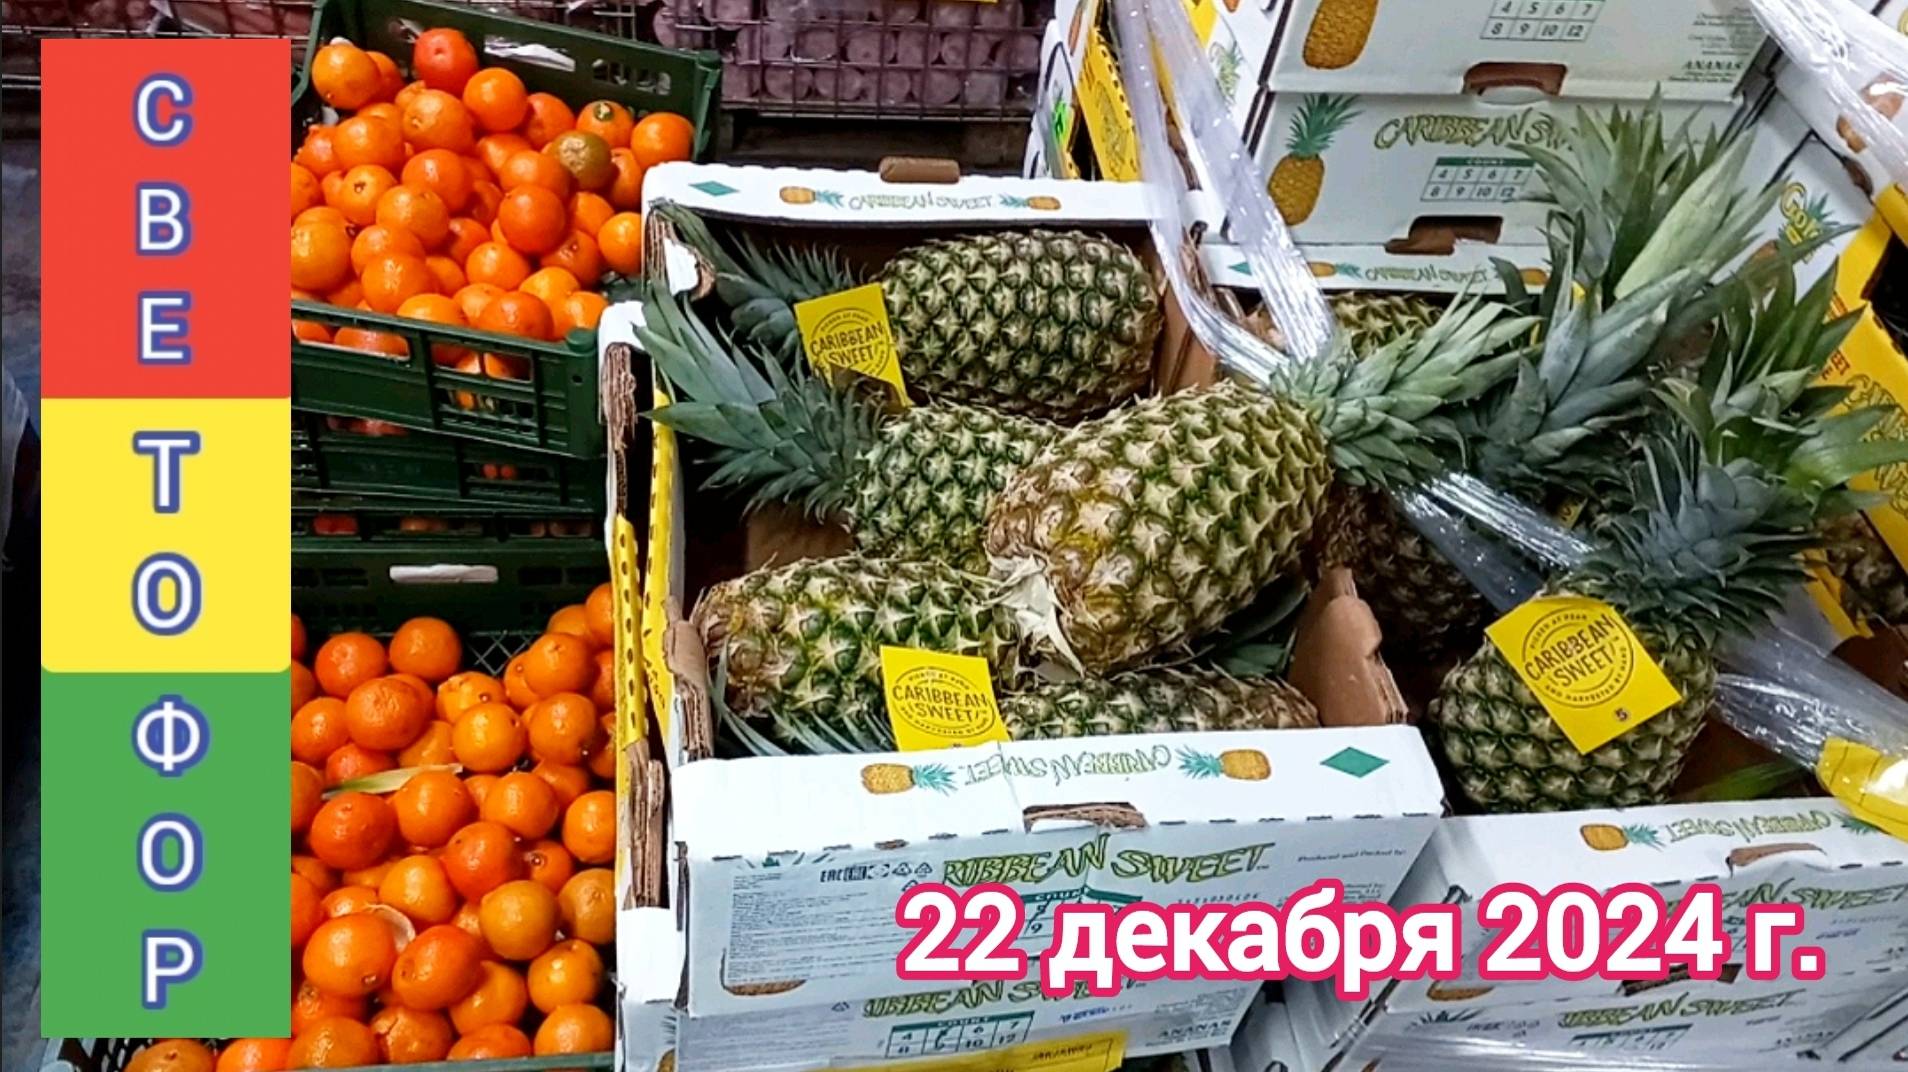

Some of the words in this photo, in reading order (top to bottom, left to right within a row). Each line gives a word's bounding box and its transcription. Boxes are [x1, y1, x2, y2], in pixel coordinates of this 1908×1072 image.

[1541, 24, 1559, 37] 10
[1373, 106, 1534, 150] CARIBBEAN
[1463, 168, 1473, 179] 5
[1487, 168, 1497, 179] 6
[1456, 186, 1466, 198] 9
[1476, 186, 1492, 198] 10
[1500, 187, 1516, 198] 12
[810, 321, 884, 357] CARIBBEAN
[828, 345, 875, 365] SWEET
[1524, 613, 1615, 681] CARIBBEAN
[1553, 645, 1614, 688] SWEET
[892, 684, 988, 707] CARIBBEAN
[914, 702, 974, 723] SWEET
[964, 752, 1048, 786] SWEET
[1051, 744, 1172, 787] CARIBBEAN
[942, 832, 1112, 887] RIBBEAN
[1111, 842, 1276, 885] SWEET
